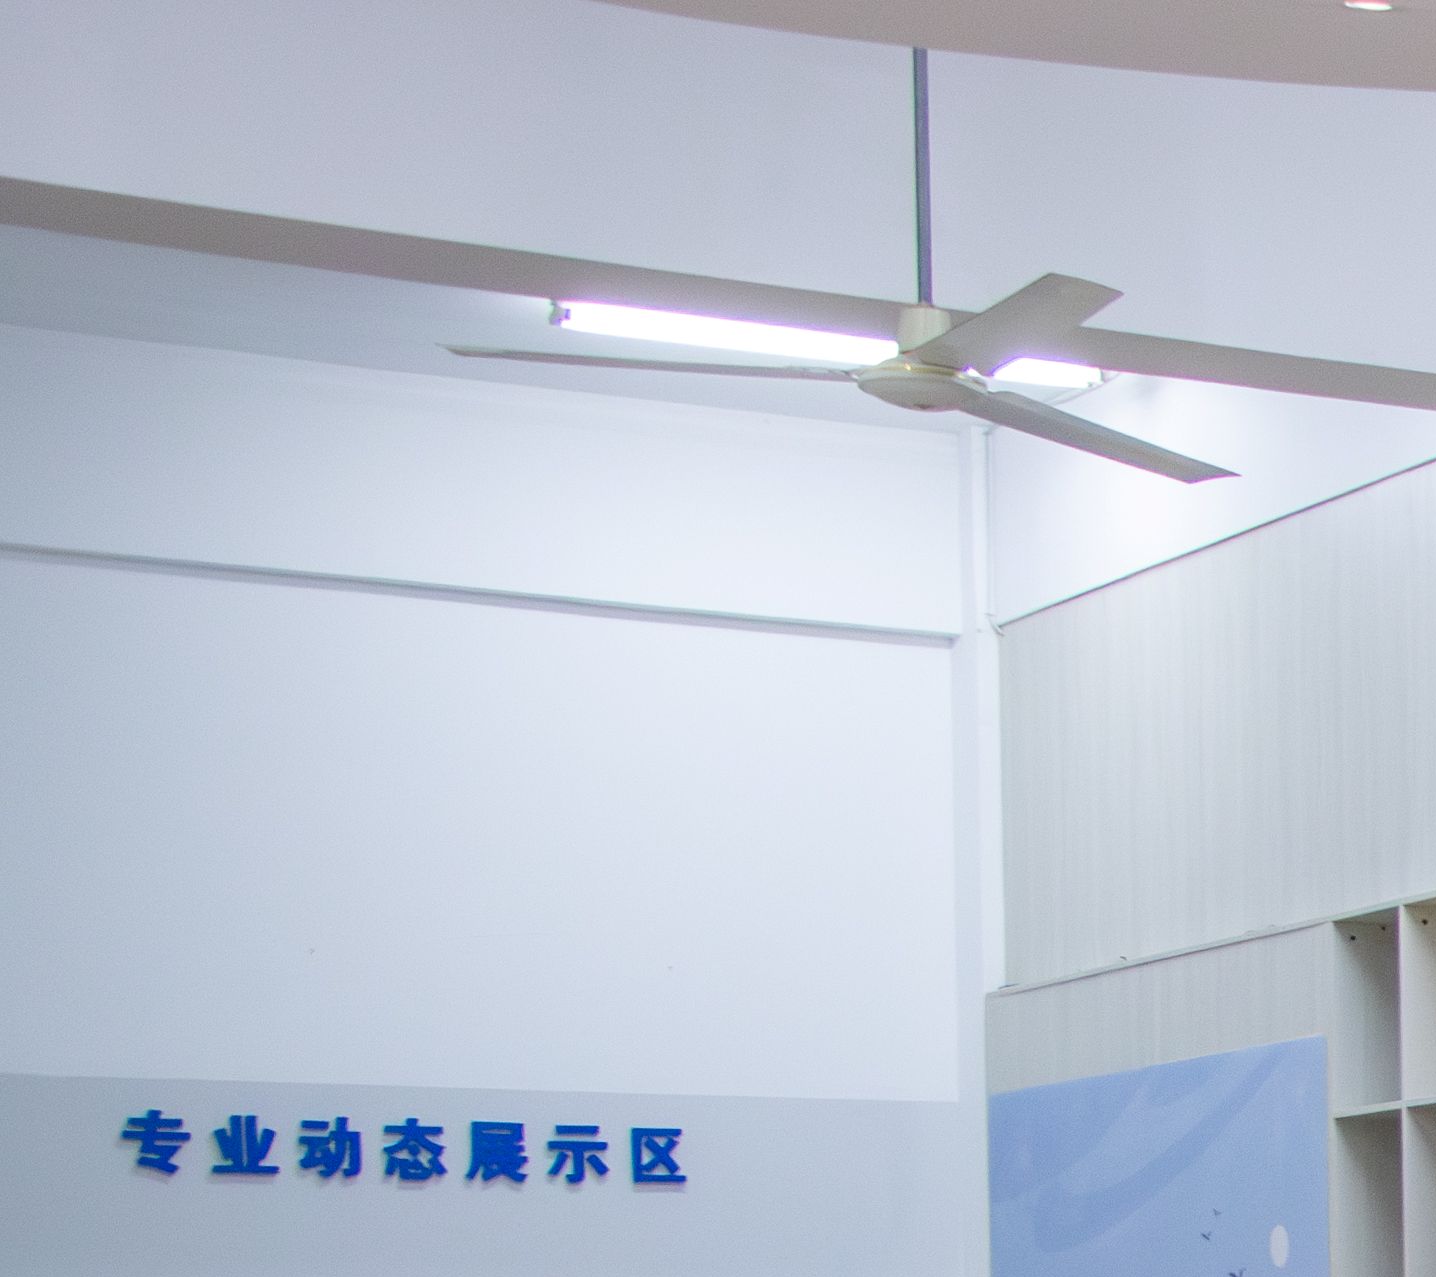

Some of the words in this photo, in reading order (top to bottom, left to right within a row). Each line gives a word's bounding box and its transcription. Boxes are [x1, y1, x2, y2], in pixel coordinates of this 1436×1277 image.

[120, 1108, 687, 1184] 专业动态展示区
